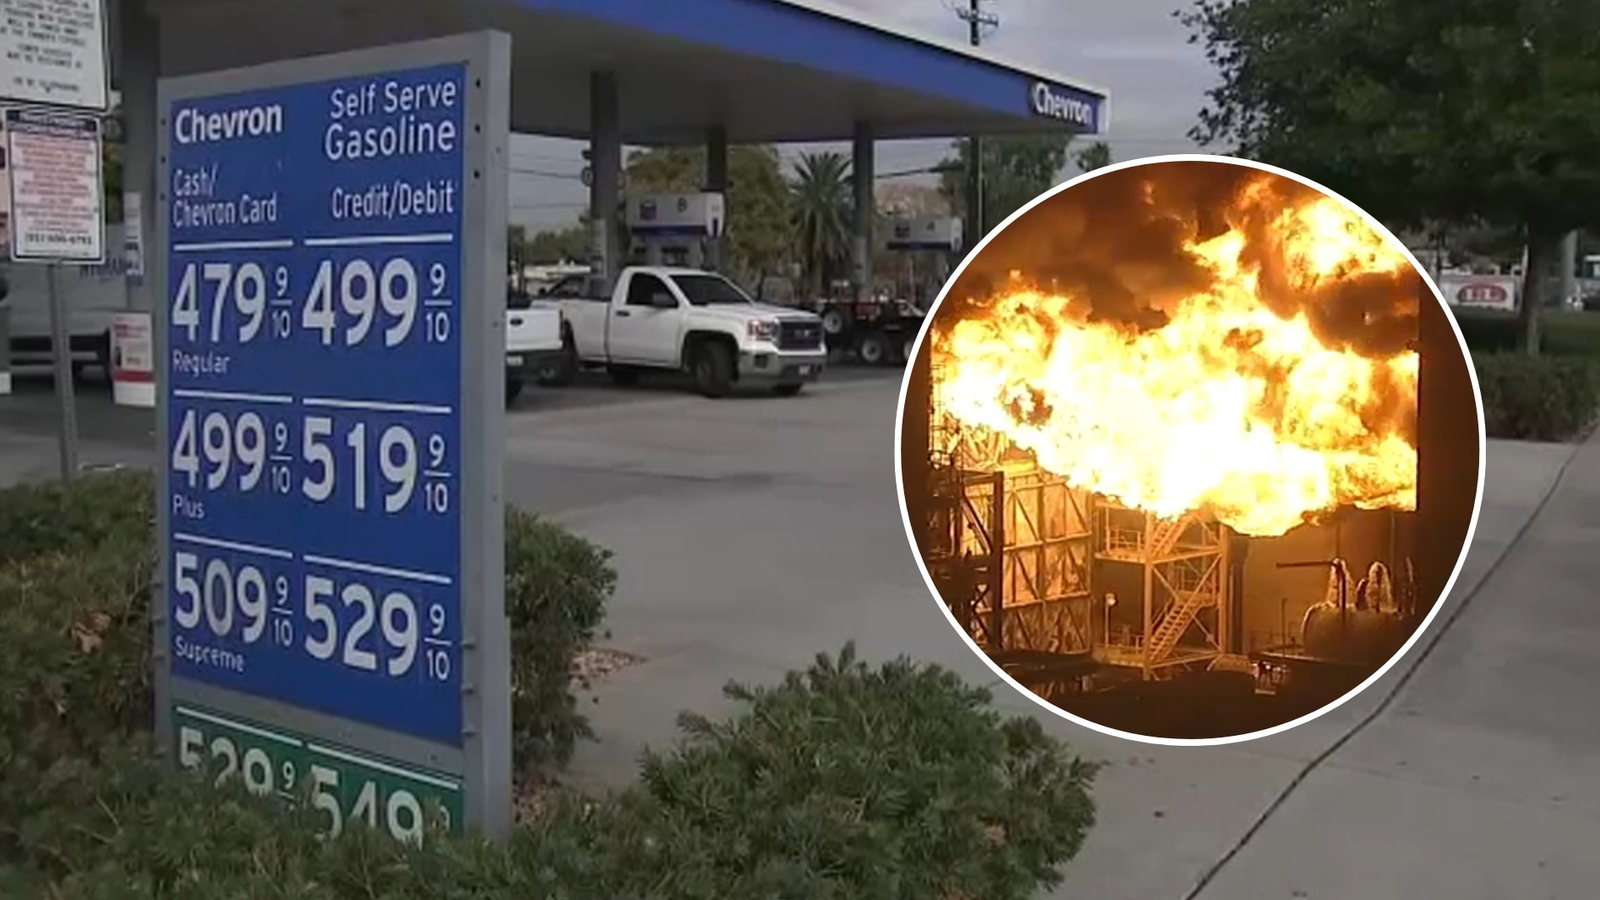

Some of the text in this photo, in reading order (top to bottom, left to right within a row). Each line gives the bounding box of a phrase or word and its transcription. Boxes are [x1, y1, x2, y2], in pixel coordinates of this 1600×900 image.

[330, 80, 456, 119] Self Serve
[1033, 82, 1092, 124] Chevron
[175, 103, 283, 144] Chevron
[324, 115, 456, 160] Gasoline
[172, 163, 219, 197] Cash/
[331, 180, 454, 219] Credit/Debit
[172, 192, 278, 228] Chevron Card
[274, 266, 289, 296] 9
[171, 262, 266, 343] 479
[302, 257, 450, 347] 499 9 10
[272, 310, 291, 339] 10
[172, 349, 230, 377] Regular
[172, 409, 291, 494] 499 9 10
[302, 416, 449, 513] 519 9 10
[172, 494, 205, 519] Plus
[174, 551, 293, 647] 509 9 10
[304, 574, 450, 680] 529 9 10
[175, 636, 245, 672] Supreme
[282, 761, 296, 790] 9
